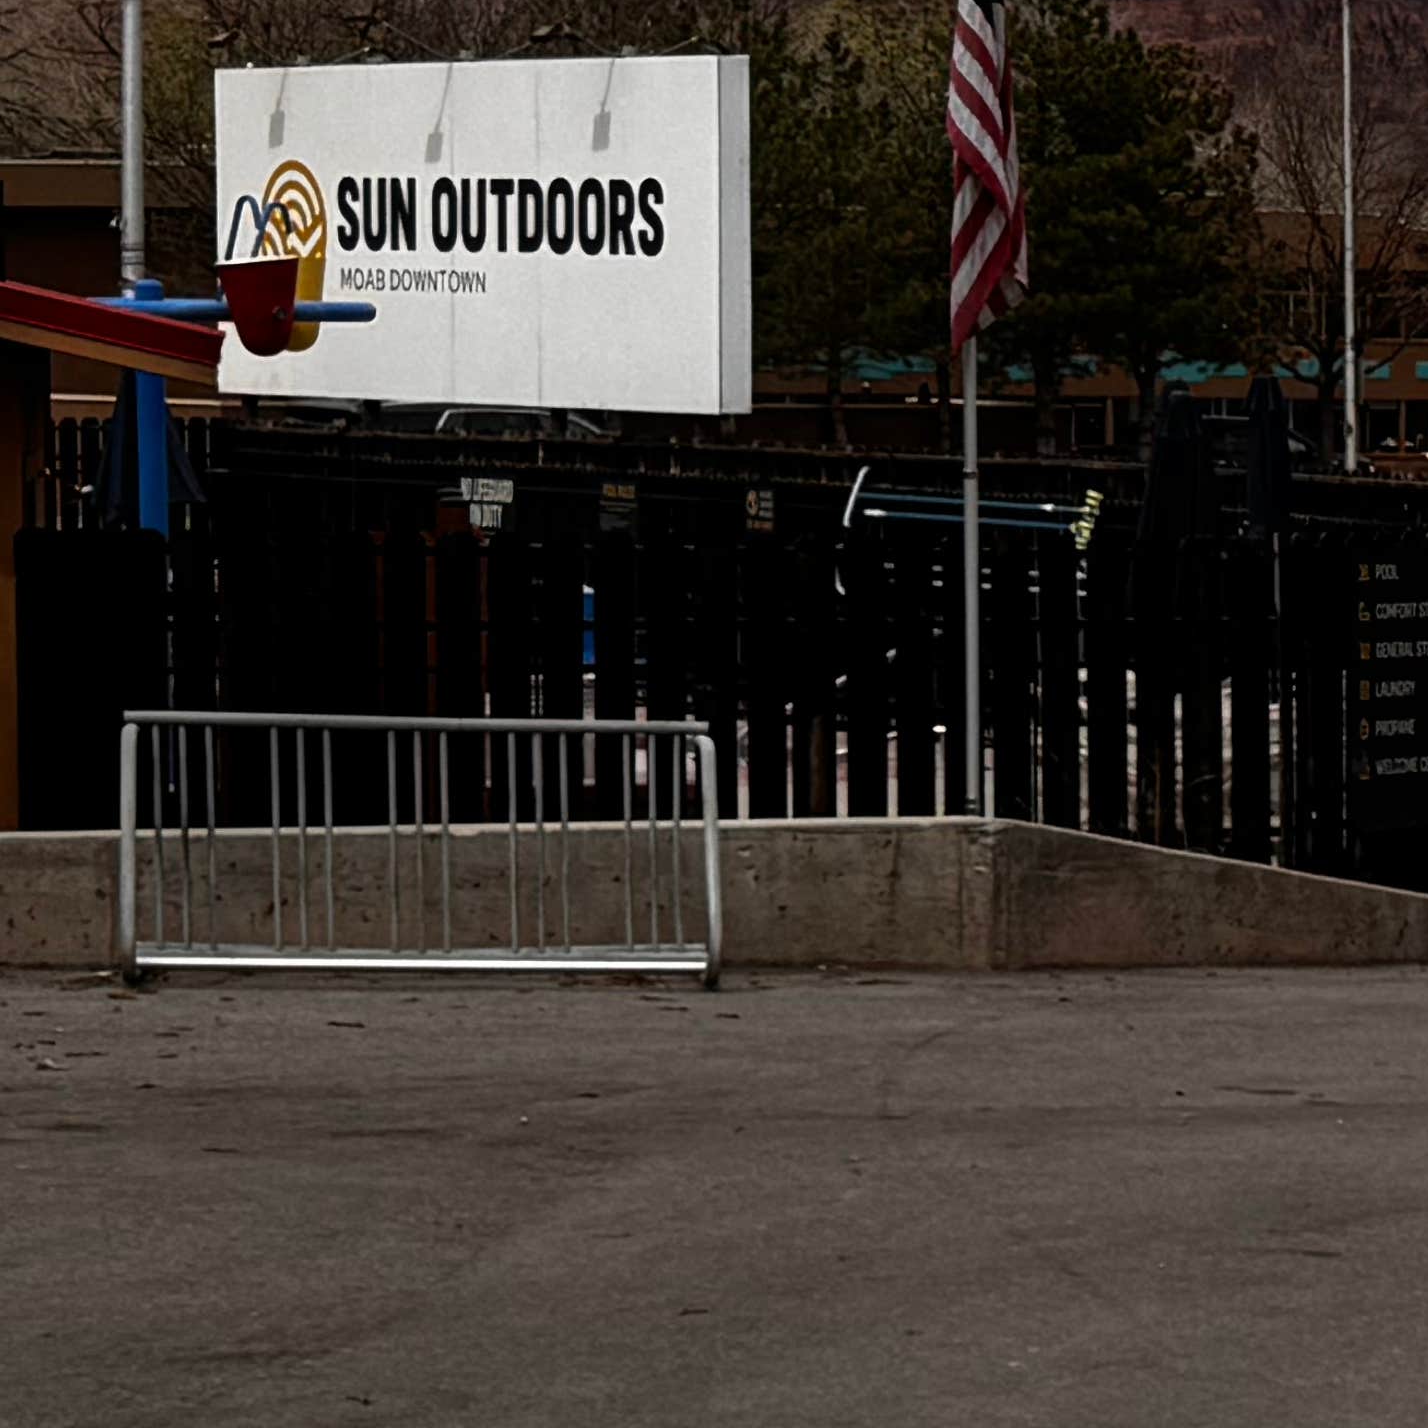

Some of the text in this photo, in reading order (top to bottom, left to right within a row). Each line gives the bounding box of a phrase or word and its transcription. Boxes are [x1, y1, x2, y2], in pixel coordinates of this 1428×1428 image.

[337, 176, 665, 257] SUN OUTDOORS
[340, 268, 486, 293] MOAB DOWNTOWN
[1375, 563, 1400, 581] POOL
[1375, 602, 1417, 620] COMFORT
[1375, 641, 1414, 659] GENERAL
[1375, 680, 1416, 698] LAUNDRY
